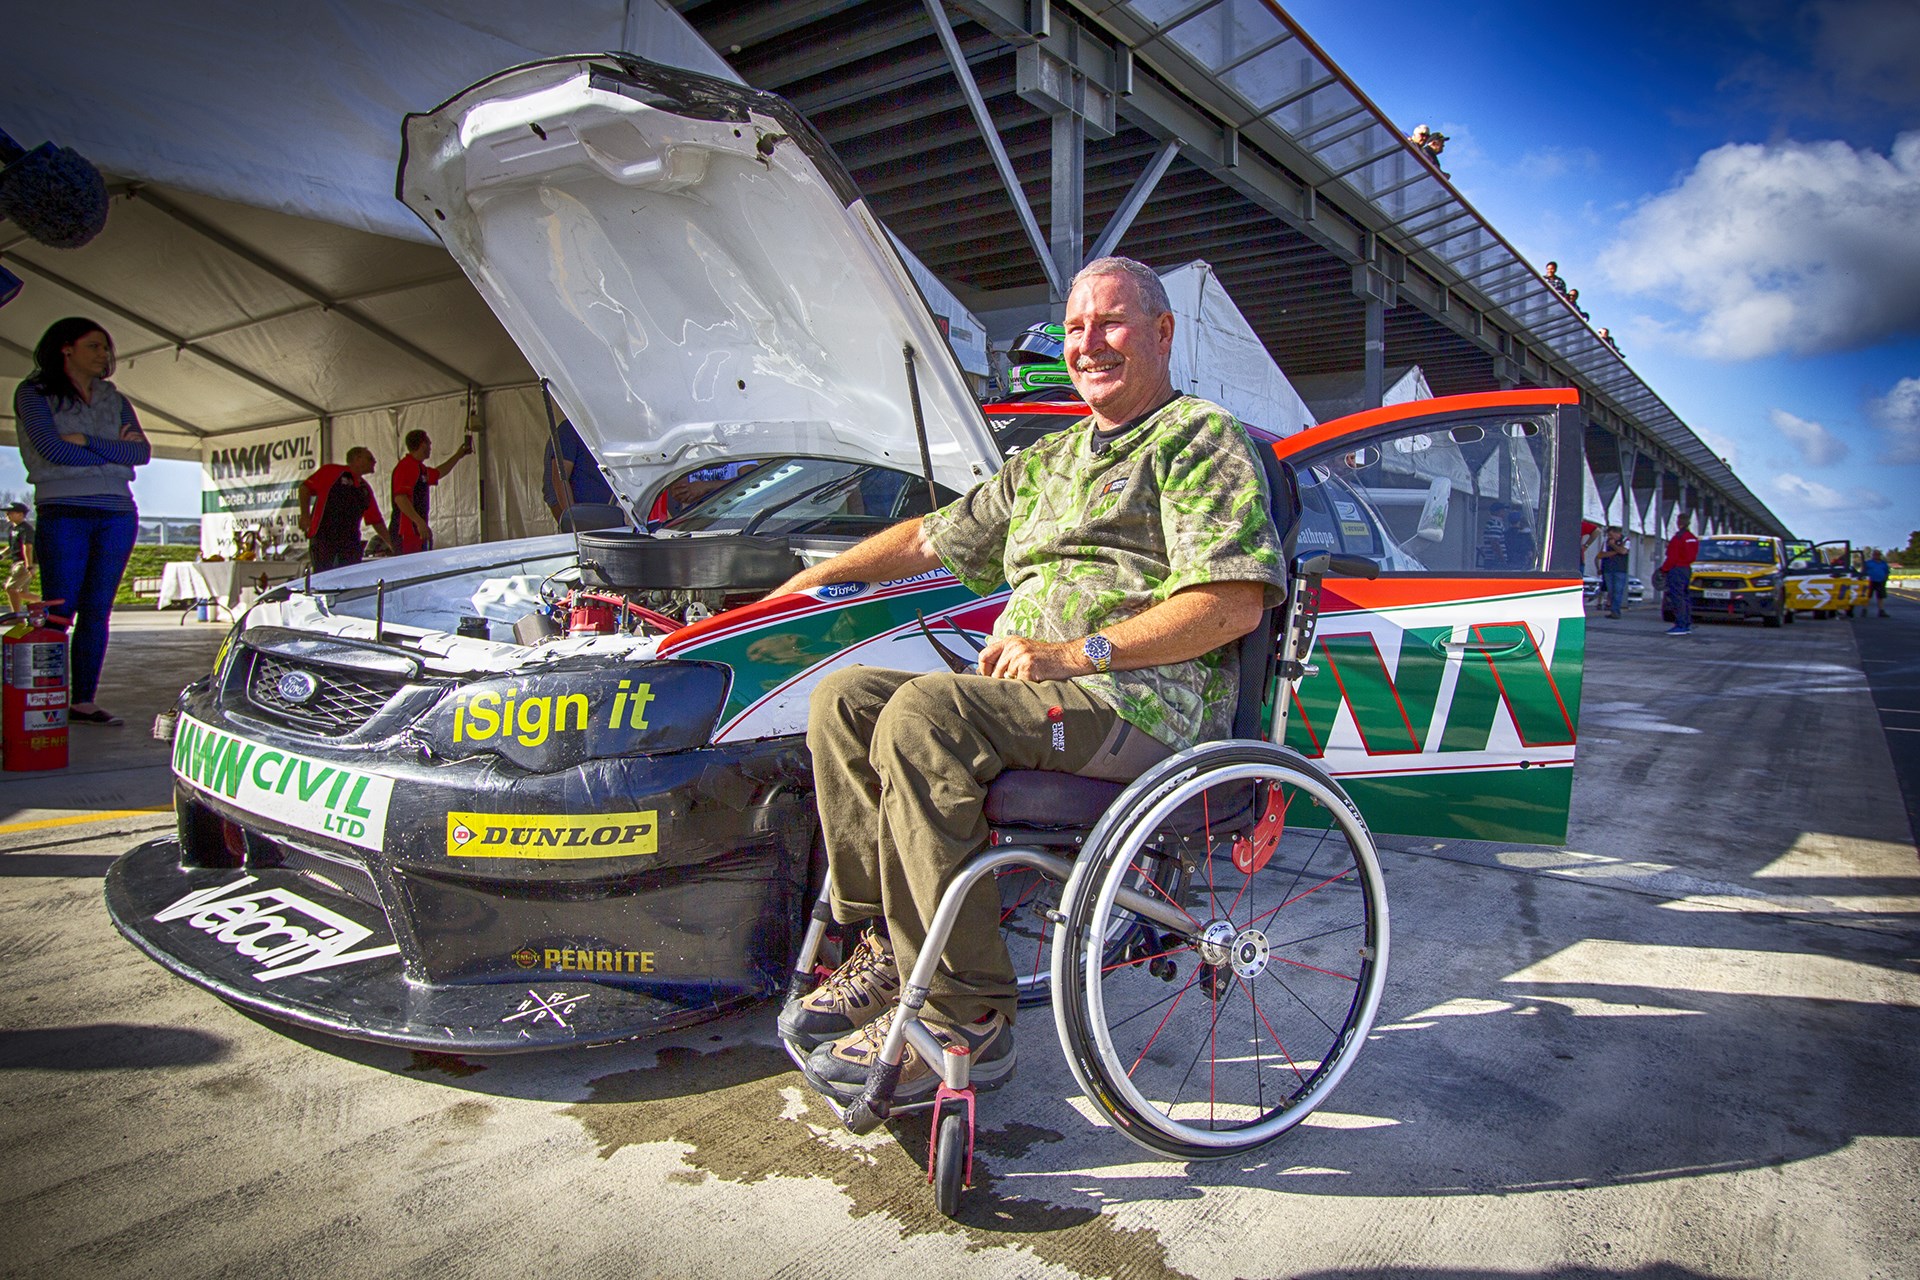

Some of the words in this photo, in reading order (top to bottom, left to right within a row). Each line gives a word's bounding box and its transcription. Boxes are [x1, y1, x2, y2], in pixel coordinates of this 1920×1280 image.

[211, 443, 274, 481] MWN
[272, 436, 313, 461] CIVIL
[298, 458, 315, 470] LTD
[257, 490, 285, 504] TRUCK
[452, 687, 589, 747] iSign
[608, 680, 656, 730] it
[173, 718, 256, 800] MWN
[252, 751, 372, 819] CIVIL
[323, 813, 365, 839] LTD
[480, 823, 652, 847] DUNLOP
[544, 949, 655, 973] PENRITE
